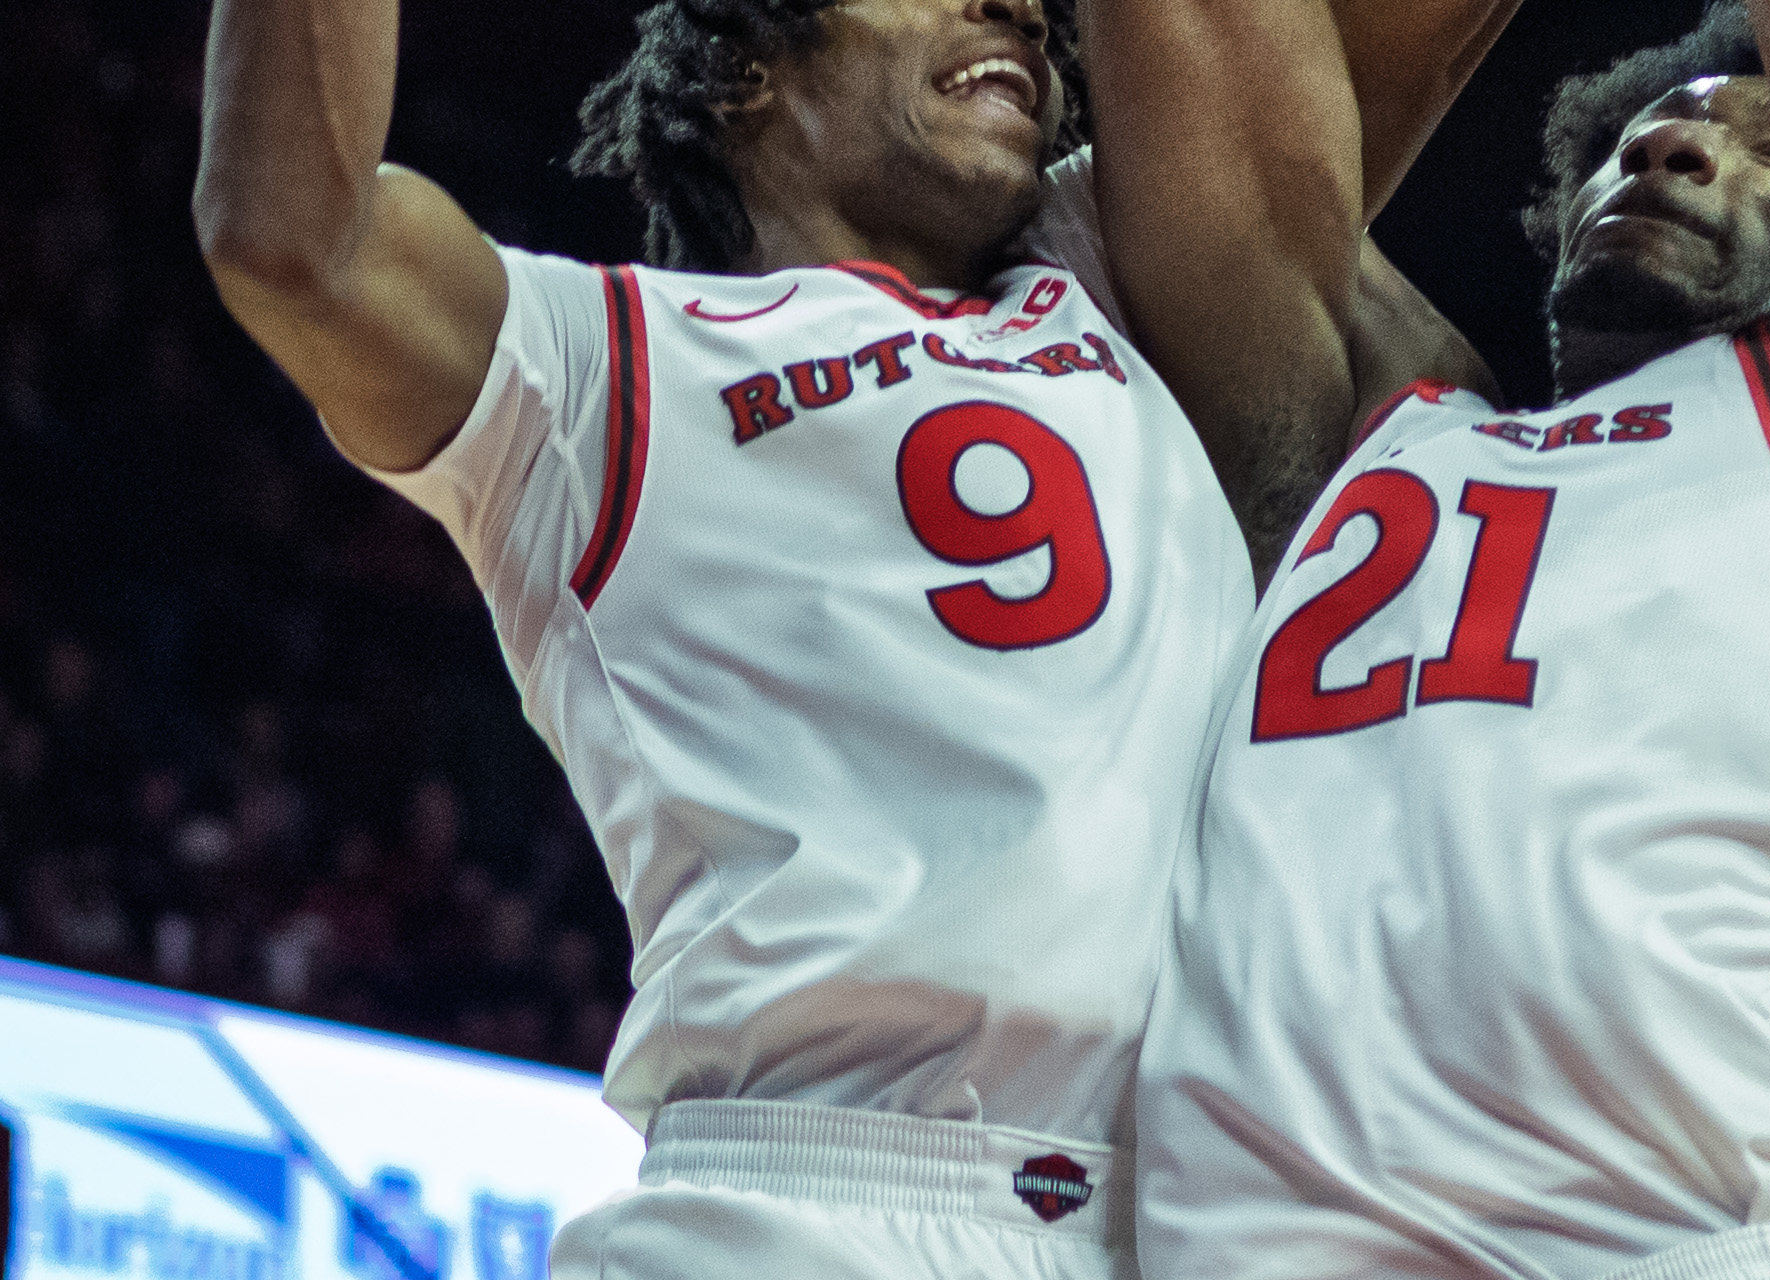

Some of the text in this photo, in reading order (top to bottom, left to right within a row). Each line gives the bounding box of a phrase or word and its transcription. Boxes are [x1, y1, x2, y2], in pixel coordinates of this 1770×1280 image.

[719, 330, 1127, 447] RUTR
[896, 400, 1112, 652] 9
[1250, 467, 1558, 744] 21
